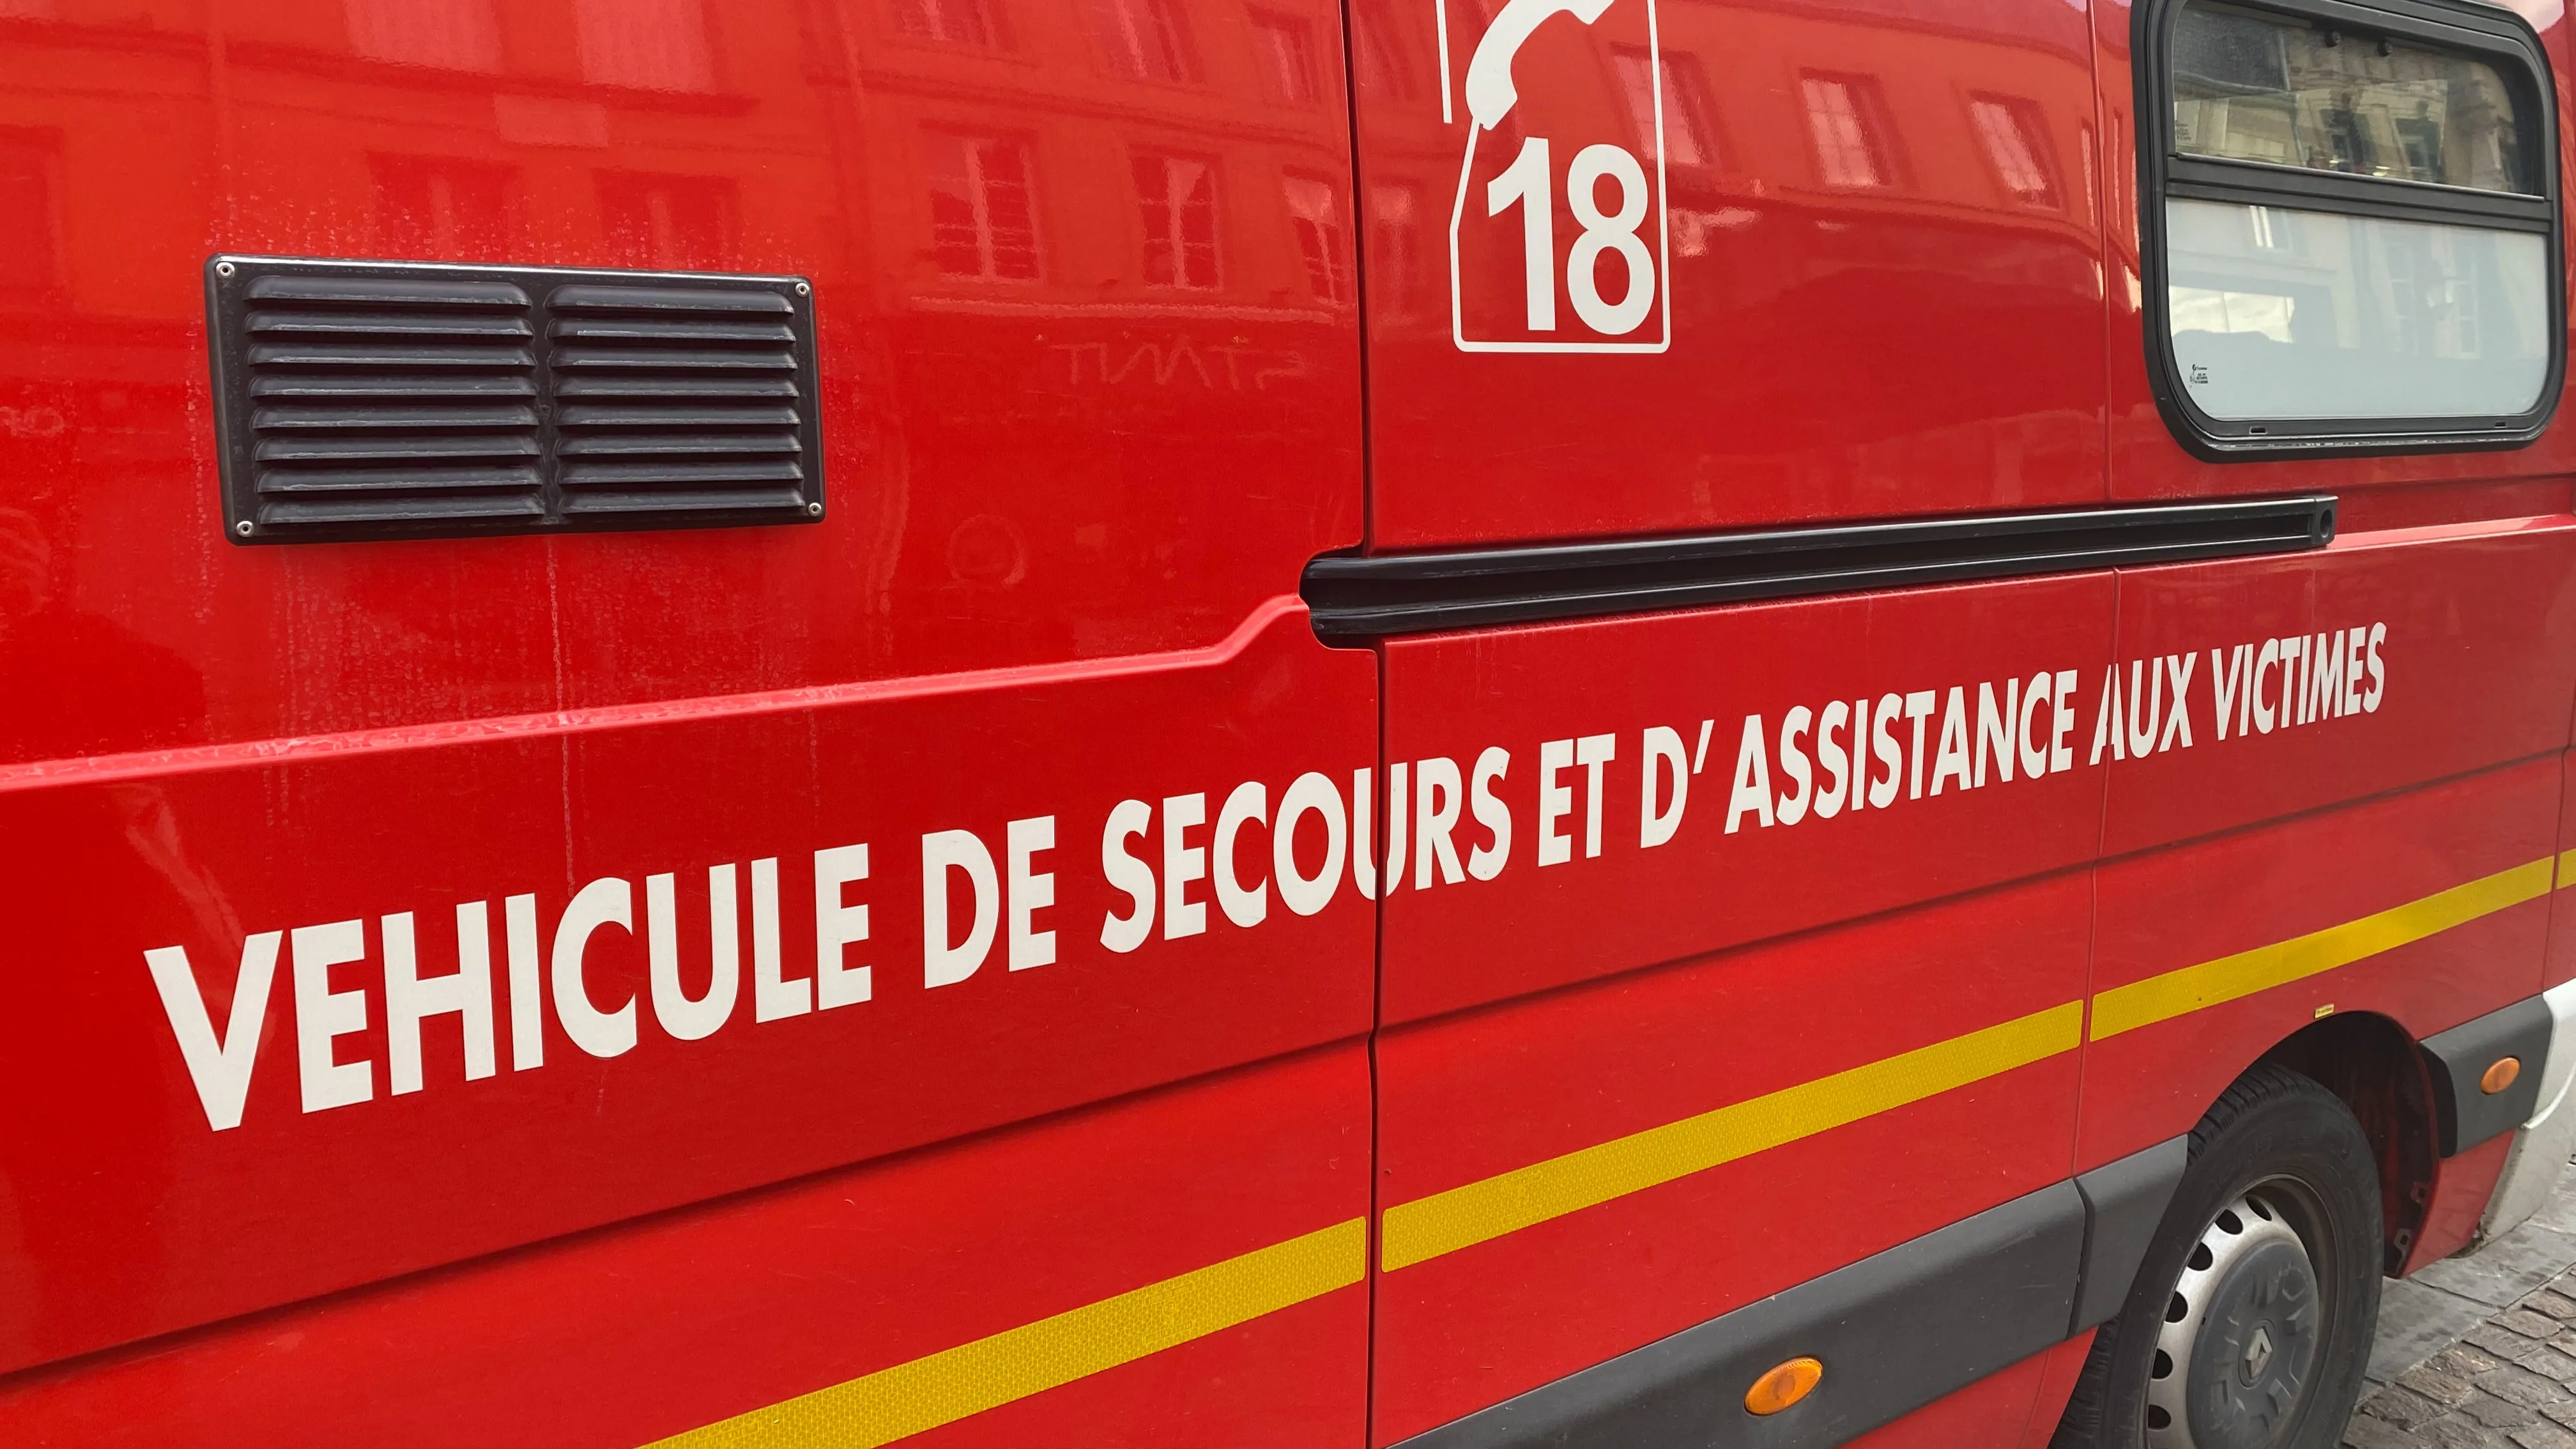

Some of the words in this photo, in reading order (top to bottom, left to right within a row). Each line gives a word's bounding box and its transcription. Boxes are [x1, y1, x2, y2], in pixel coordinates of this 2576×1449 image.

[1487, 136, 1655, 335] 18
[143, 843, 871, 1131] VEHICULE
[922, 815, 1056, 989] DE
[1100, 746, 1512, 953] SECOURS
[1538, 733, 1616, 867] ET
[1724, 669, 2078, 834] ASSISTANCE
[2089, 652, 2198, 766] AUX
[2211, 622, 2387, 741] VICTIMES
